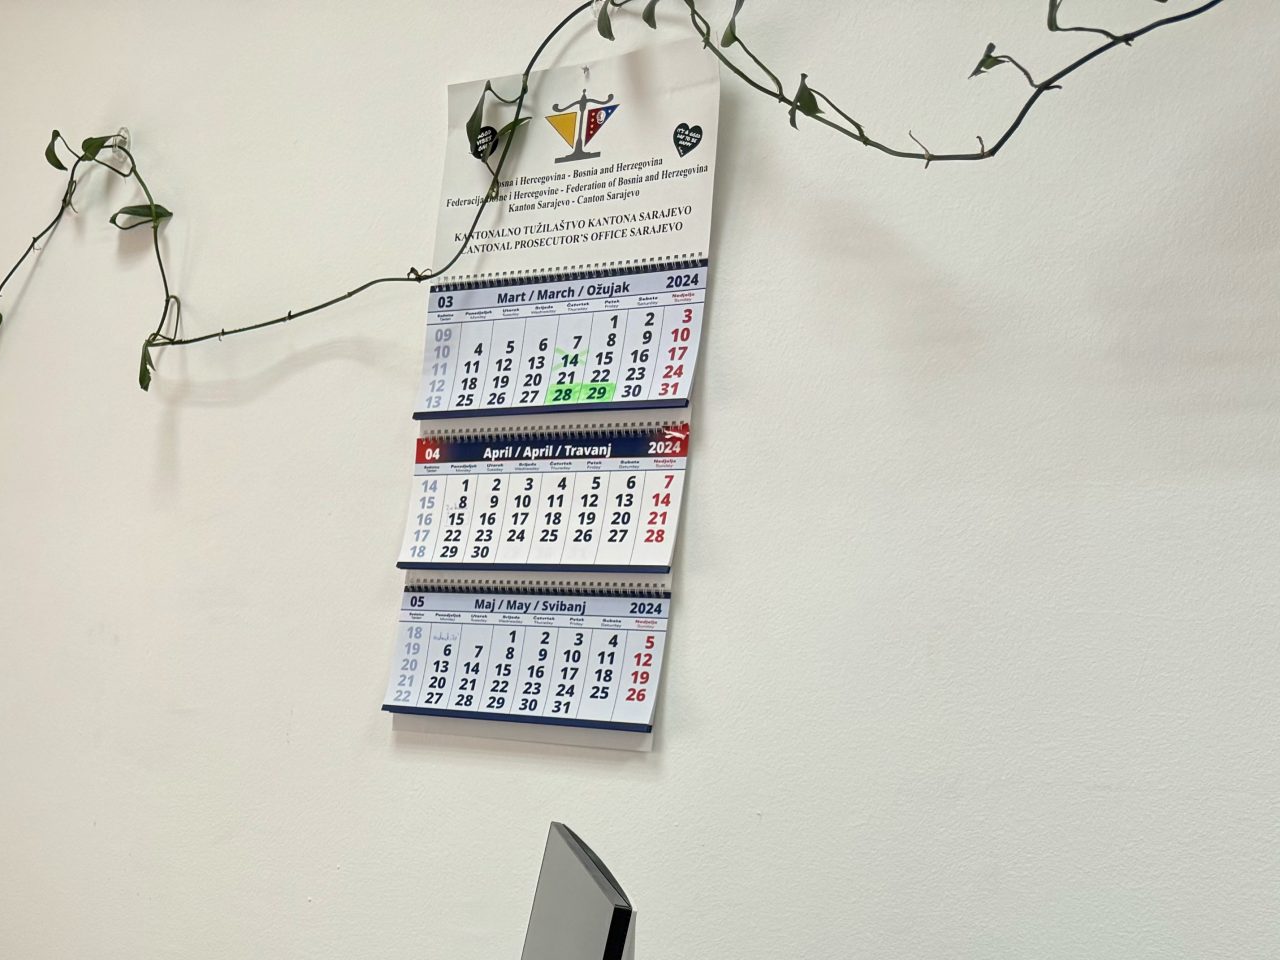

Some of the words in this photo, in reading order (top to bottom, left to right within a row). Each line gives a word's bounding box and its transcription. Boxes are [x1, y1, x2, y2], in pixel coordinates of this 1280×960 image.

[509, 192, 512, 200] i
[514, 186, 559, 200] Hercegovine
[566, 181, 606, 193] Federation
[608, 178, 617, 187] of
[618, 175, 643, 186] Bosnia
[645, 172, 659, 182] and
[662, 164, 708, 179] Herzegovina
[515, 178, 518, 186] i
[520, 172, 566, 186] Hercegovina
[573, 167, 598, 178] Bosnia
[600, 164, 614, 174] and
[616, 158, 663, 172] Herzegovina
[508, 202, 535, 212] Kanton
[538, 199, 570, 209] Sarajevo
[577, 195, 604, 204] Canton
[606, 189, 640, 200] Sarajevo
[523, 220, 585, 235] TUŽILAŠTVO
[588, 214, 636, 228] KANTONA
[639, 205, 692, 221] SARAJEVO
[462, 242, 512, 254] ANTONAL
[591, 229, 627, 241] OFFICE
[630, 221, 683, 237] SARAJEVO
[438, 296, 453, 308] 03
[497, 292, 525, 304] Mart
[537, 287, 575, 301] March
[586, 282, 630, 297] Ožujak
[666, 274, 699, 289] 2024
[610, 315, 618, 329] 1
[644, 312, 655, 326] 2
[682, 308, 692, 324] 3
[474, 342, 483, 356] 4
[506, 340, 515, 354] 5
[538, 338, 548, 352] 6
[573, 335, 582, 349] 7
[606, 333, 616, 347] 8
[642, 330, 652, 345] 9
[671, 327, 690, 342] 10
[464, 360, 480, 374] 11
[496, 358, 512, 372] 12
[528, 356, 545, 370] 13
[561, 354, 579, 368] 14
[596, 351, 614, 366] 15
[630, 348, 650, 363] 16
[668, 346, 688, 361] 17
[461, 377, 478, 390] 18
[493, 375, 509, 388] 19
[523, 373, 542, 387] 20
[556, 371, 575, 385] 21
[590, 369, 610, 383] 22
[625, 366, 646, 381] 23
[662, 364, 684, 379] 24
[456, 394, 474, 407] 25
[487, 392, 506, 405] 26
[519, 390, 540, 403] 27
[552, 388, 572, 402] 28
[586, 386, 606, 400] 29
[621, 384, 642, 398] 30
[658, 382, 679, 396] 31
[425, 448, 440, 460] 04
[483, 446, 513, 460] April
[523, 445, 554, 459] April
[564, 444, 612, 458] Travanj
[648, 441, 681, 454] 2024
[462, 479, 469, 492] 1
[492, 478, 501, 491] 2
[524, 478, 534, 491] 3
[557, 477, 567, 490] 4
[591, 476, 601, 490] 5
[626, 476, 636, 489] 6
[664, 475, 674, 489] 7
[458, 496, 468, 509] 8
[490, 495, 499, 508] 9
[514, 494, 531, 508] 10
[547, 494, 564, 508] 11
[581, 494, 598, 507] 12
[616, 493, 634, 507] 13
[652, 493, 671, 507] 14
[449, 513, 464, 526] 15
[480, 512, 496, 525] 16
[512, 512, 529, 525] 17
[544, 512, 562, 525] 18
[578, 512, 596, 525] 19
[610, 512, 631, 525] 20
[648, 511, 667, 525] 21
[444, 529, 462, 542] 22
[474, 529, 493, 542] 23
[506, 529, 525, 542] 24
[540, 529, 558, 542] 25
[573, 529, 592, 542] 26
[608, 529, 628, 542] 27
[644, 529, 665, 543] 28
[440, 546, 458, 558] 29
[471, 546, 490, 558] 30
[410, 596, 425, 607] 05
[474, 599, 495, 613] Maj
[506, 600, 531, 613] May
[542, 600, 586, 614] Svibanj
[630, 602, 662, 614] 2024
[509, 630, 516, 643] 1
[540, 631, 550, 644] 2
[574, 632, 584, 646] 3
[608, 634, 618, 648] 4
[645, 636, 655, 650] 5
[443, 644, 452, 656] 6
[474, 645, 484, 658] 7
[506, 646, 515, 660] 8
[538, 648, 548, 661] 9
[563, 650, 581, 663] 10
[598, 651, 615, 665] 11
[634, 652, 652, 667] 12
[433, 660, 449, 673] 13
[464, 662, 480, 675] 14
[495, 664, 512, 676] 15
[528, 665, 544, 678] 16
[561, 667, 579, 680] 17
[595, 669, 613, 682] 18
[631, 670, 650, 684] 19
[428, 676, 446, 689] 20
[458, 678, 476, 691] 21
[490, 680, 509, 693] 22
[522, 682, 542, 695] 23
[556, 684, 575, 697] 24
[590, 686, 610, 699] 25
[626, 688, 646, 702] 26
[424, 692, 444, 704] 27
[454, 694, 474, 707] 28
[486, 696, 505, 709] 29
[518, 698, 538, 711] 30
[552, 700, 570, 714] 31
